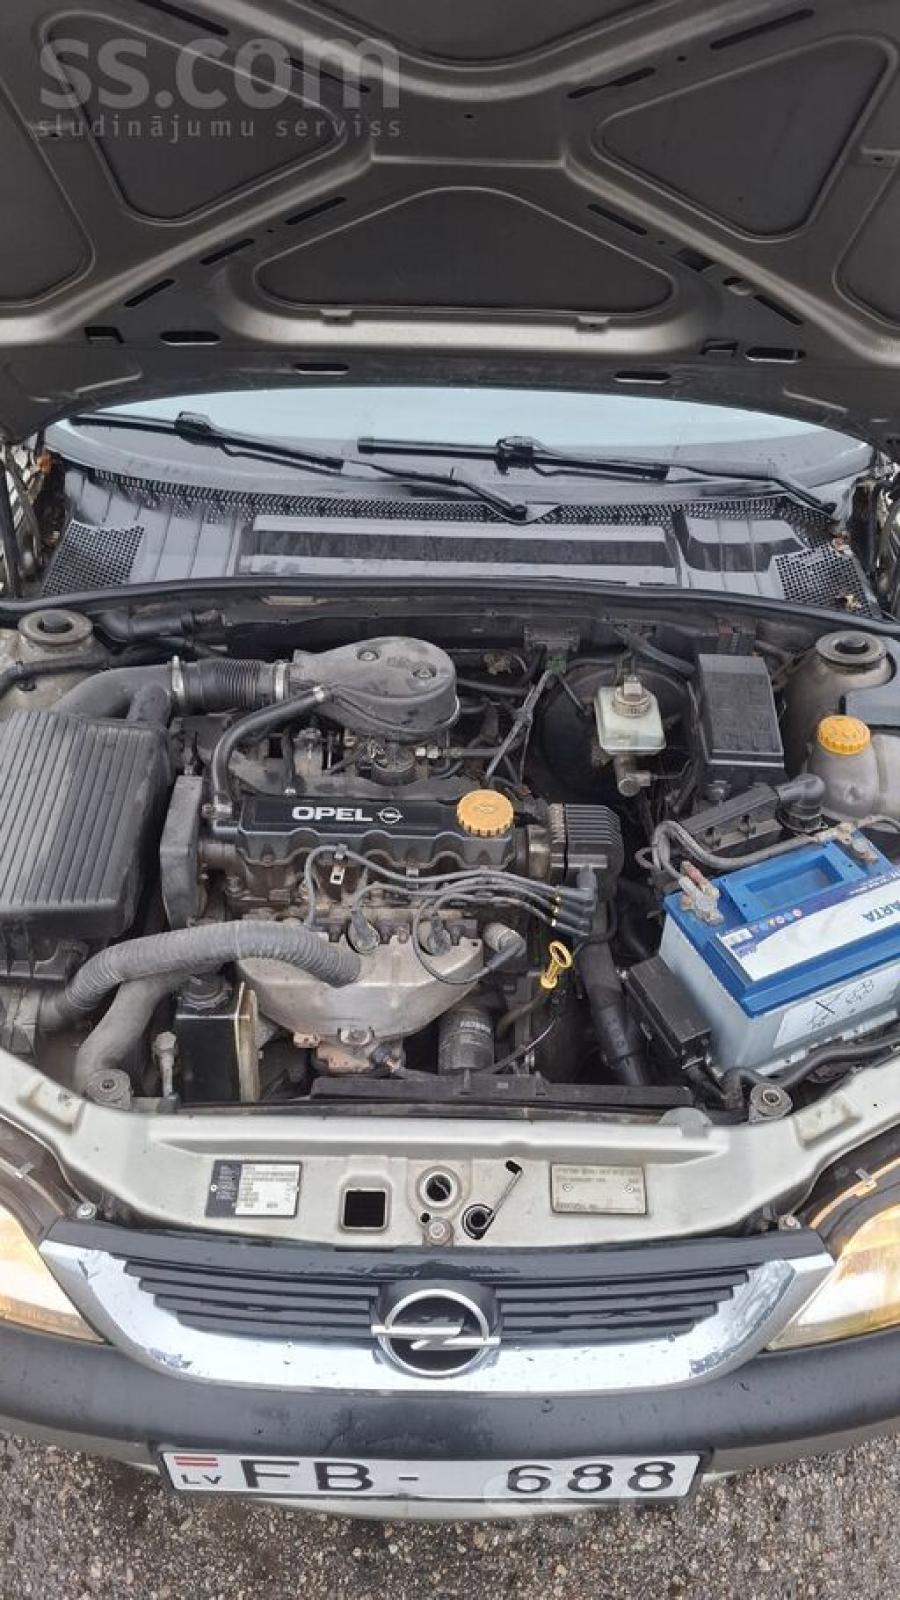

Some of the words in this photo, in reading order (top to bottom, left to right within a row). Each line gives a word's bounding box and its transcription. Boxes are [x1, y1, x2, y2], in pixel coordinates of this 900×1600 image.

[292, 806, 373, 822] OPEL
[181, 1474, 222, 1485] LV
[507, 1461, 675, 1493] 688
